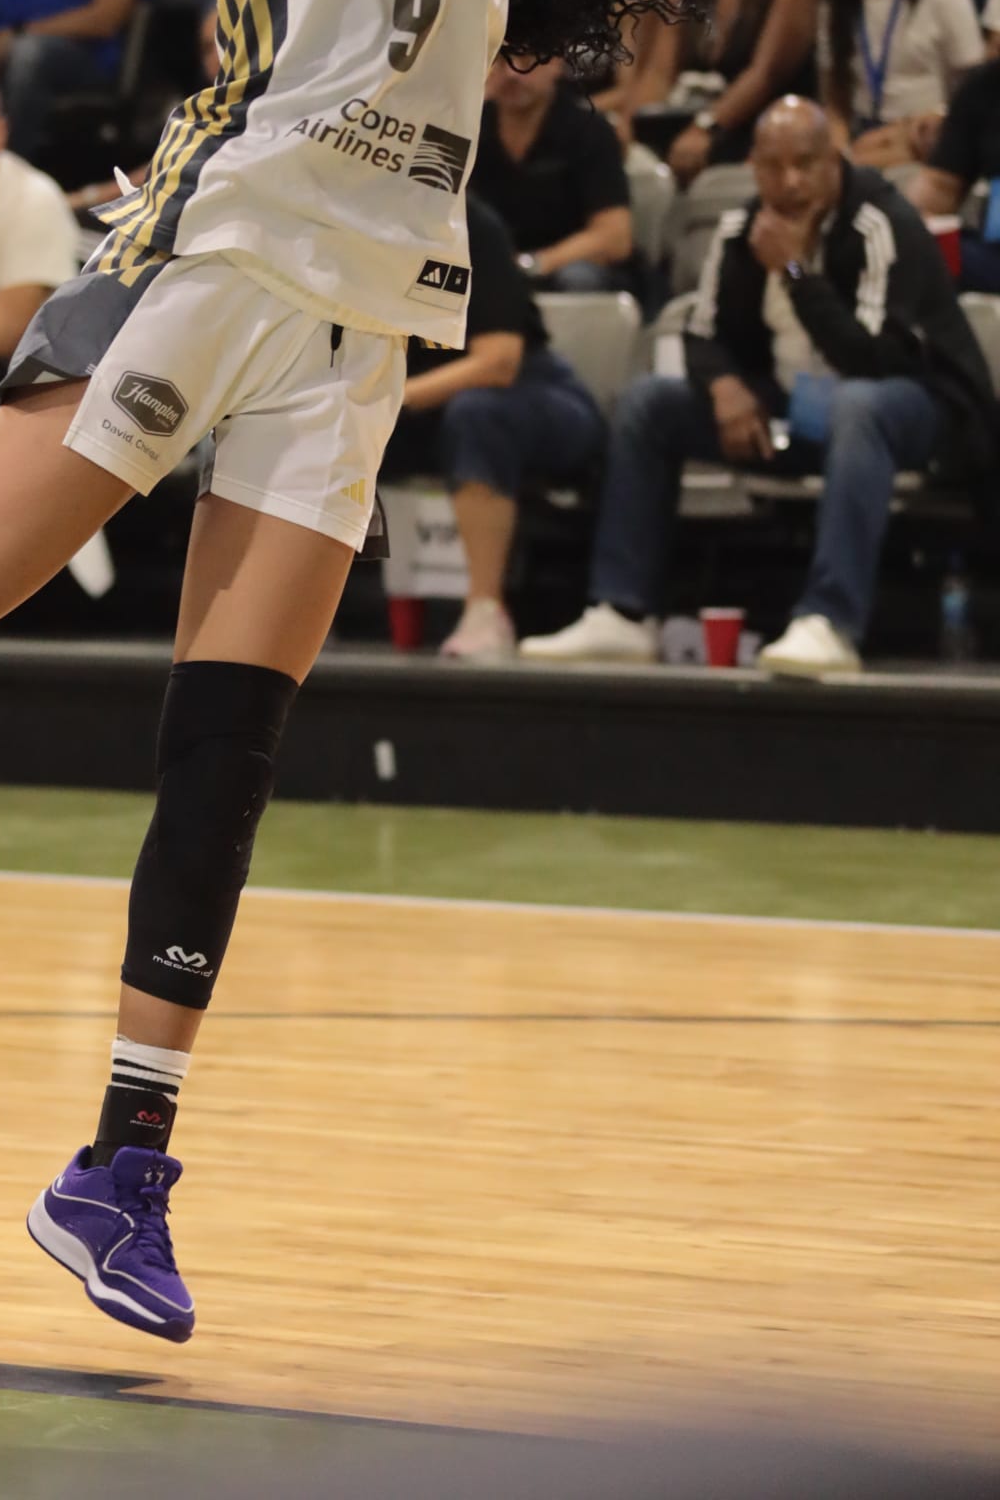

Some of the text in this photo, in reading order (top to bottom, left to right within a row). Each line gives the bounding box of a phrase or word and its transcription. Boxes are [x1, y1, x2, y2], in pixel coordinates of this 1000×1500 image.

[340, 98, 417, 145] Copa
[285, 118, 405, 174] Airlines
[119, 381, 180, 426] Hampton
